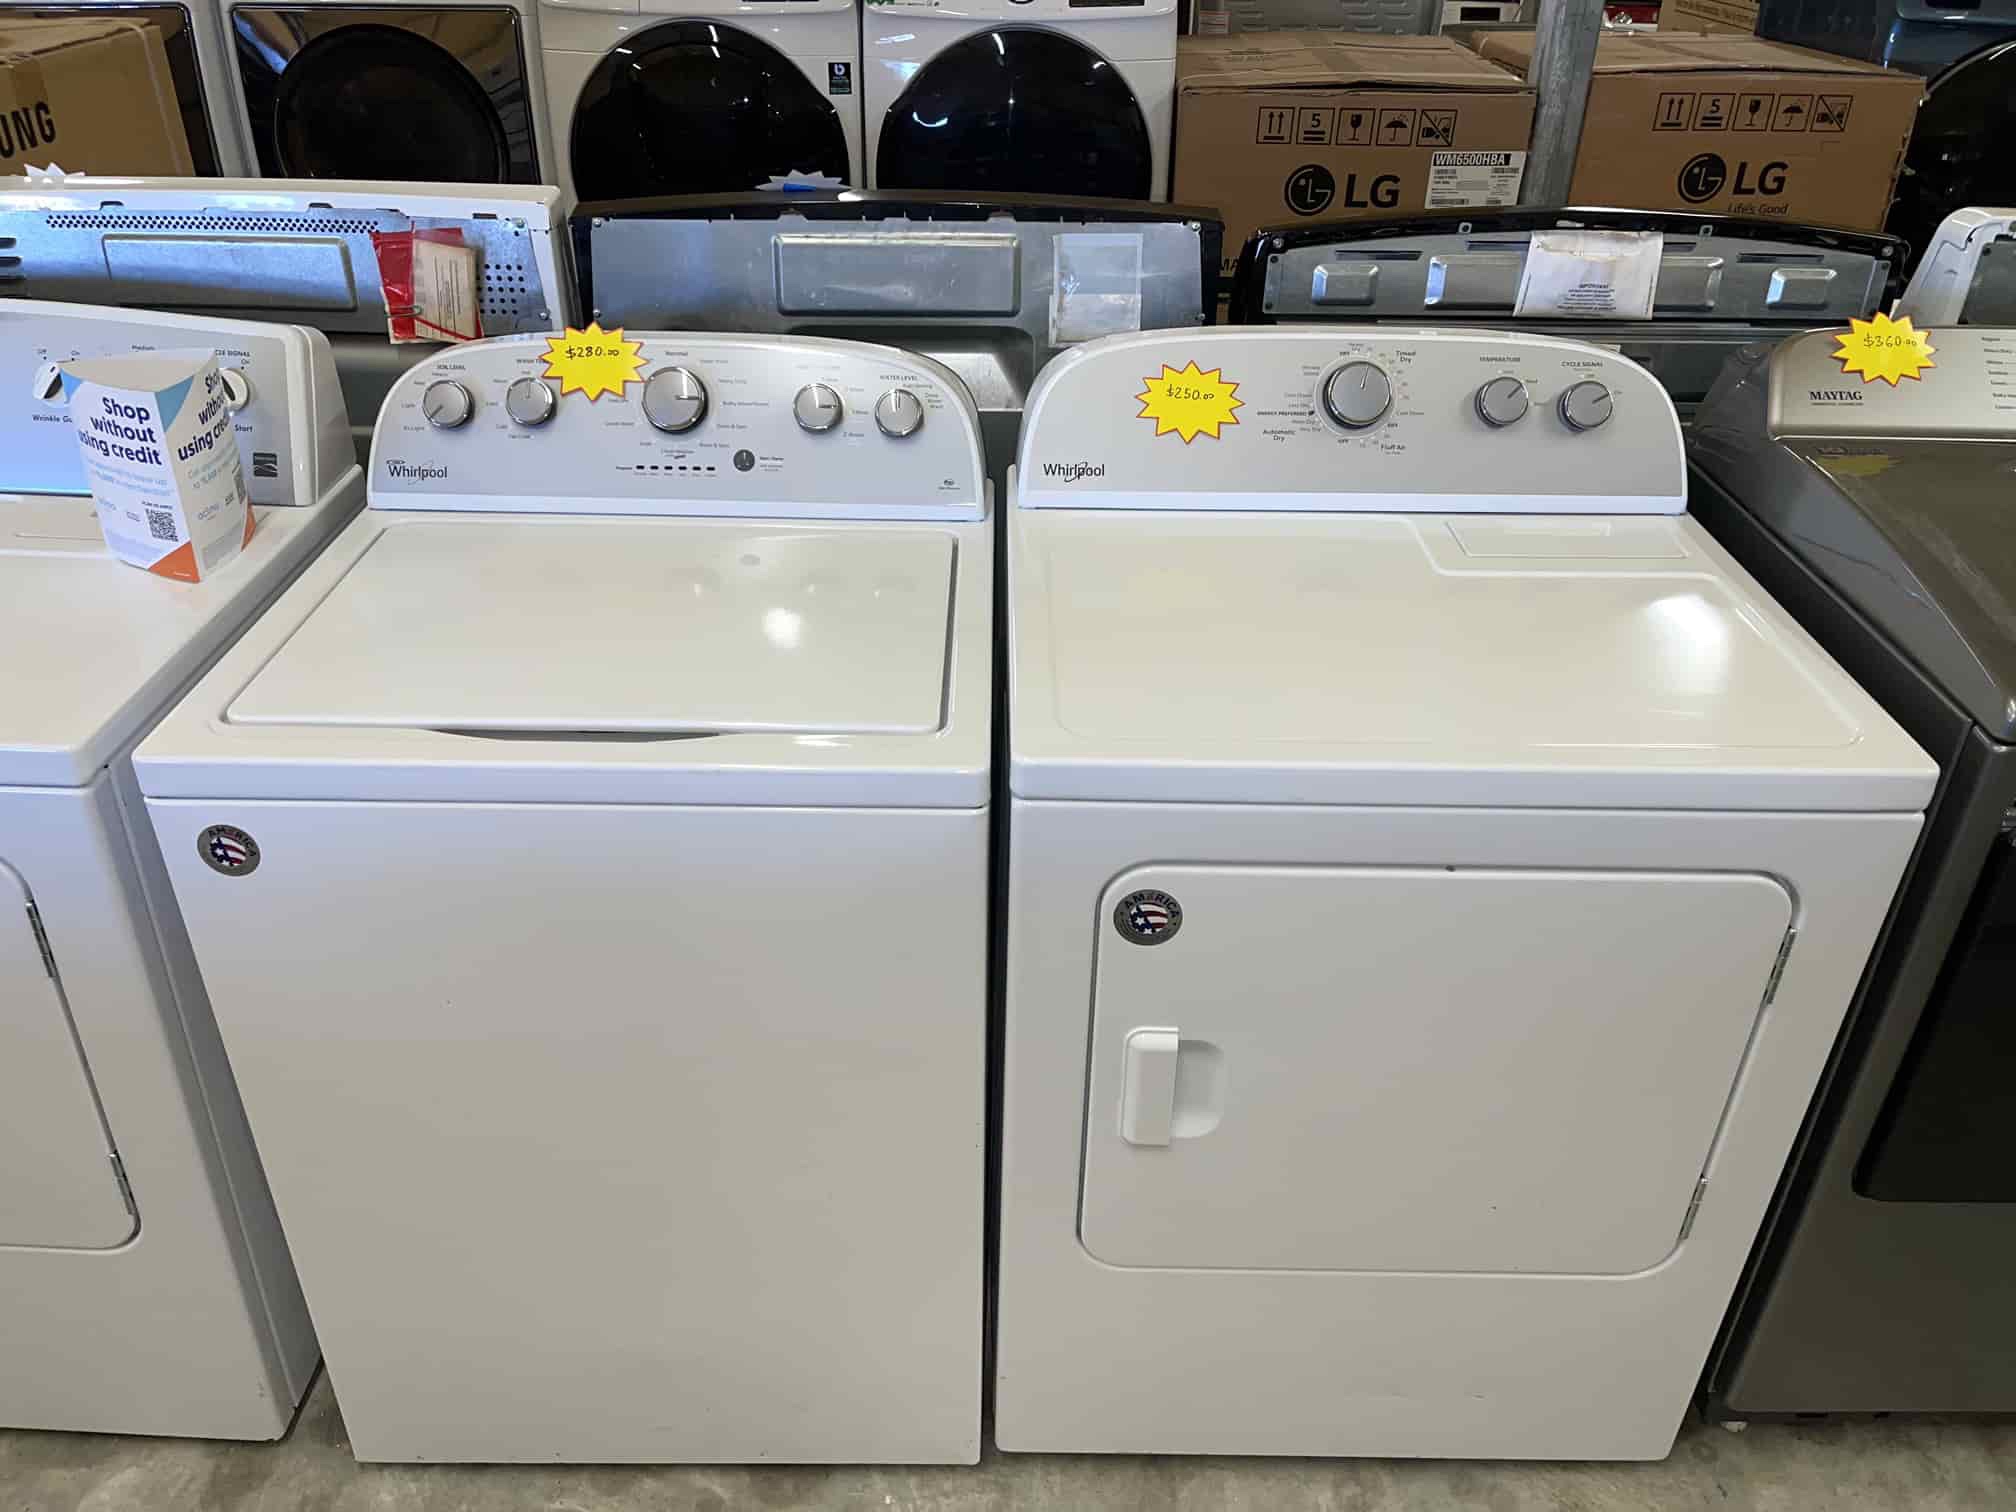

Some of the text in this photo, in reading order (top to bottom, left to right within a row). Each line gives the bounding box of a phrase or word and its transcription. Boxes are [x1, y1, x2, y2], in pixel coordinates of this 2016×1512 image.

[1435, 153, 1506, 166] WM6500HBA
[1732, 161, 1789, 196] LG
[1343, 173, 1401, 209] LG
[1758, 203, 1789, 215] Good
[1809, 390, 1863, 401] MAYTAG
[102, 396, 150, 425] Shop
[90, 416, 156, 443] without
[111, 444, 162, 466] credit
[178, 432, 213, 461] using
[387, 463, 448, 483] Whirlpool
[1043, 462, 1105, 482] Whirlpool
